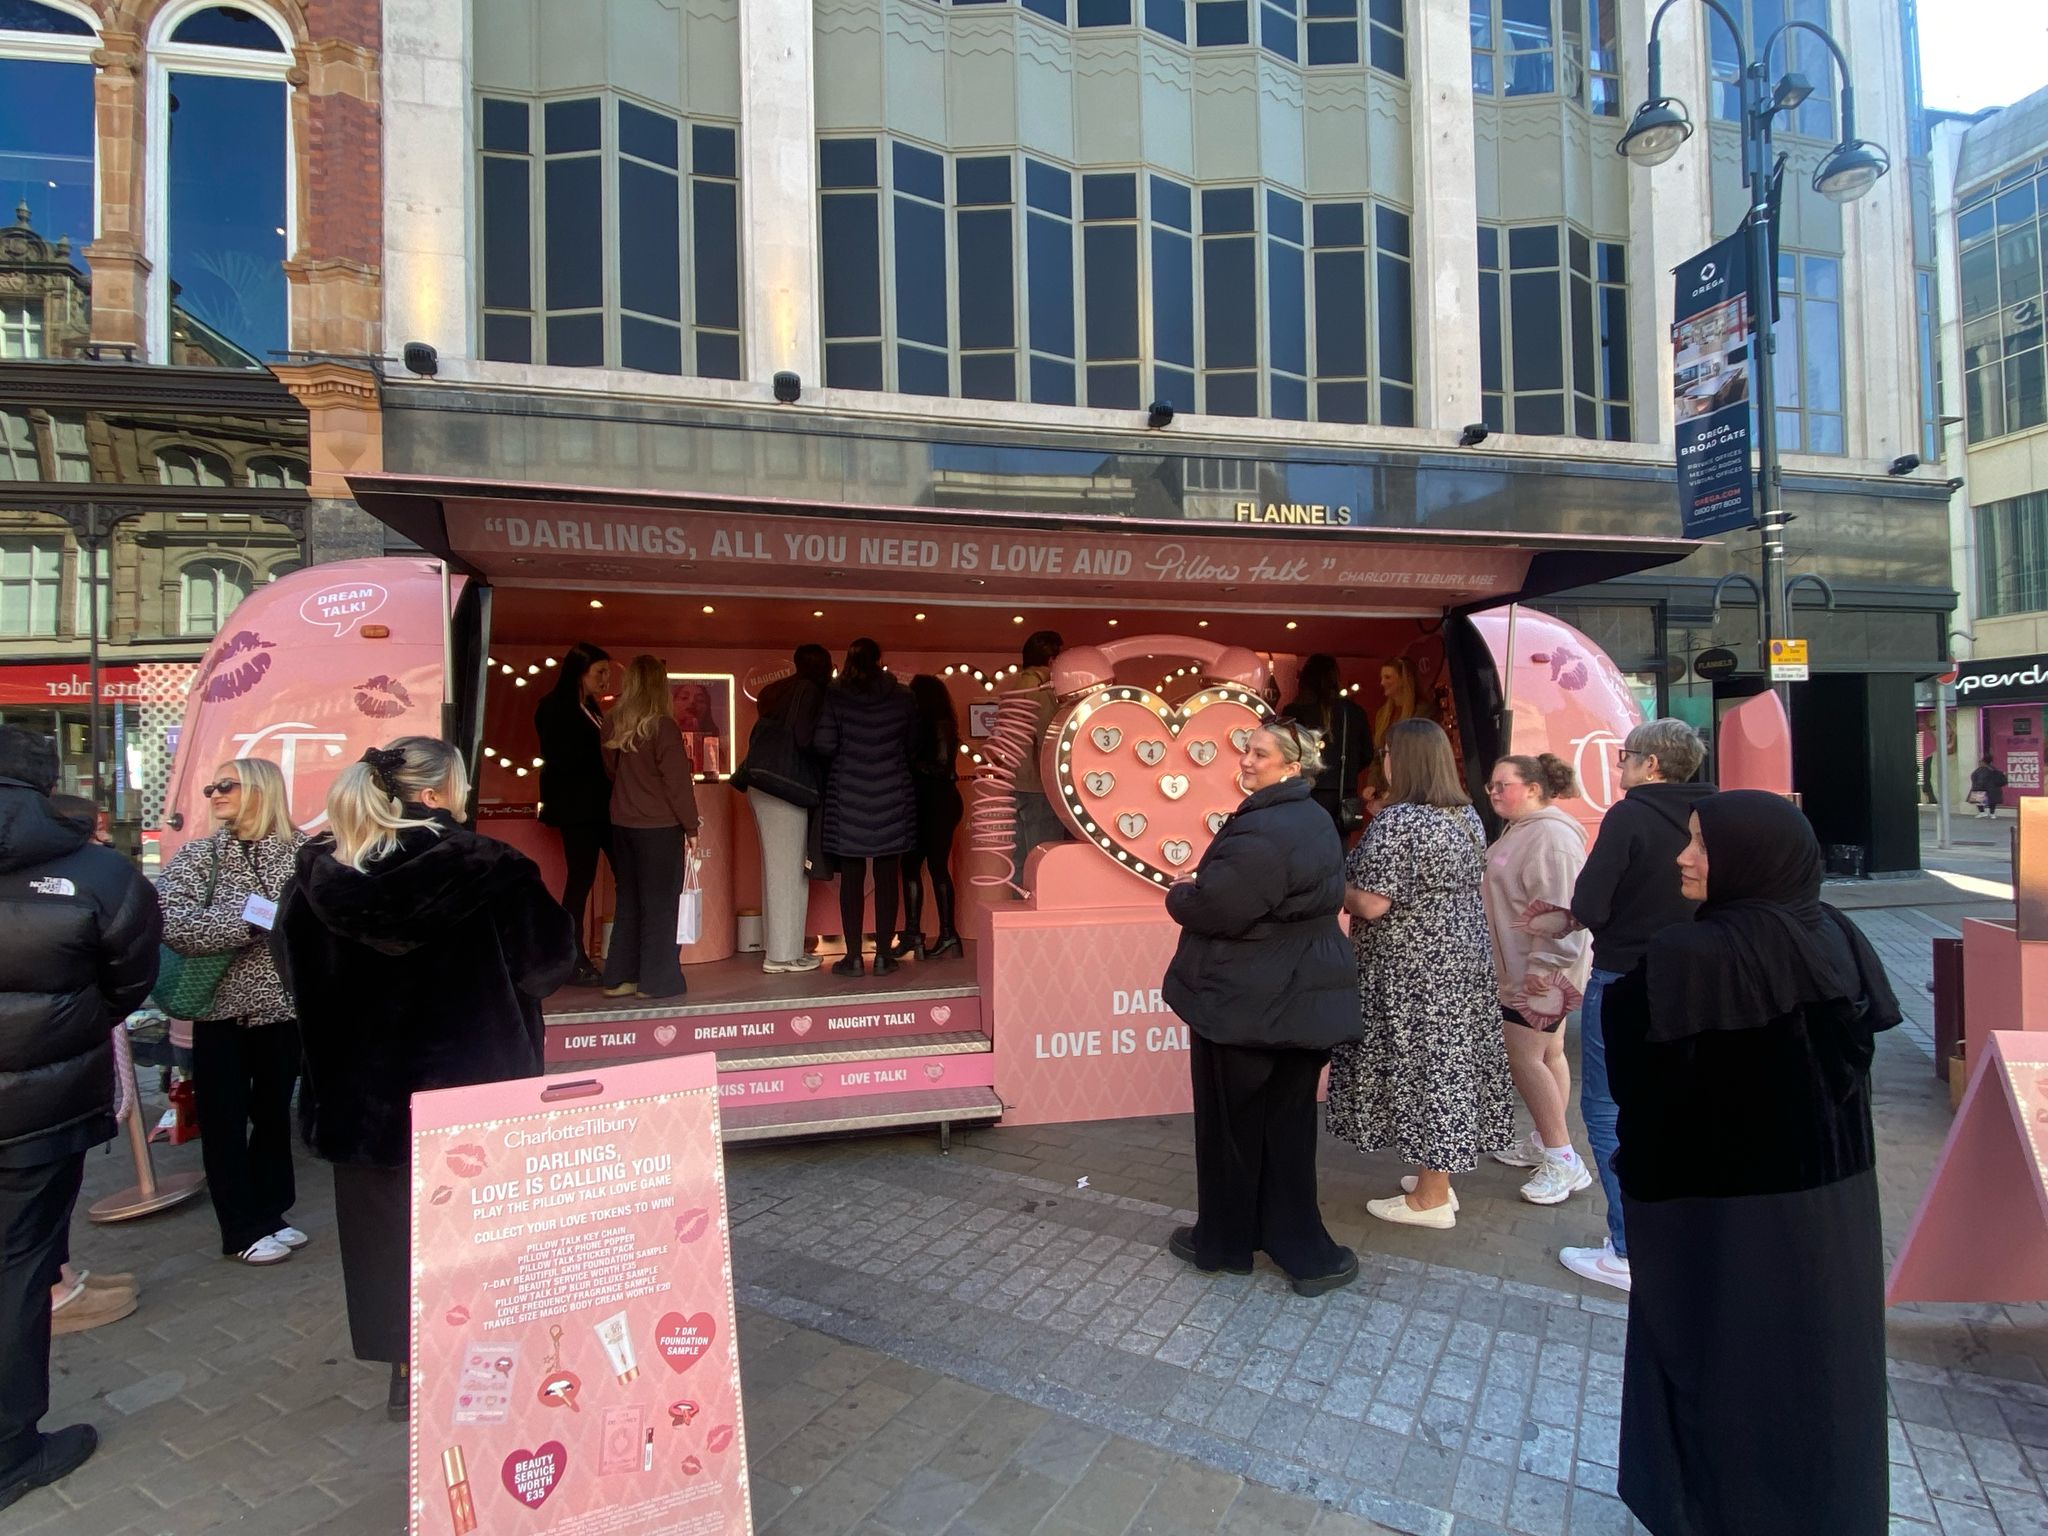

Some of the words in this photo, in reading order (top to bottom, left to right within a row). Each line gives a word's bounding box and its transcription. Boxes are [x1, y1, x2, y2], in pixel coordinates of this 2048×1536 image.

[1692, 276, 1725, 297] OREGA
[1681, 440, 1717, 456] BROAD
[1719, 428, 1746, 444] GATE
[1697, 424, 1731, 441] OREGA
[1714, 448, 1743, 462] OFFICES
[1718, 457, 1742, 469] ROOMS
[1715, 465, 1743, 479] OFFICES
[1235, 502, 1352, 526] FLANNELS
[710, 529, 772, 560] ALL
[783, 533, 848, 564] YOU
[860, 537, 939, 568] NEED
[951, 542, 980, 569] IS
[990, 544, 1063, 574] LOVE
[1072, 549, 1133, 577] AND
[1145, 544, 1239, 583] Pillow
[1338, 570, 1411, 585] CHARLOTTE
[1469, 574, 1498, 586] MBE
[317, 587, 373, 606] DREAM
[322, 601, 367, 618] TALK!
[751, 668, 791, 687] NAUGHTY
[1954, 664, 2048, 695] perd
[1103, 734, 1111, 747] 3
[1147, 748, 1154, 760] 4
[2007, 764, 2039, 774] LASH
[2007, 773, 2040, 783] NAILS
[1095, 779, 1103, 791] 2
[1170, 782, 1178, 794] 5
[1113, 988, 1173, 1016] DAR
[828, 1014, 881, 1031] NAUGHTY
[883, 1012, 915, 1028] TALK!
[565, 1034, 599, 1049] LOVE
[601, 1031, 636, 1047] TALK!
[694, 1025, 738, 1041] DREAM
[740, 1022, 775, 1038] TALK!
[1035, 1030, 1101, 1059] LOVE
[1112, 1029, 1136, 1054] IS
[1146, 1025, 1190, 1052] CAL
[749, 1080, 784, 1095] TALK!
[840, 1072, 873, 1087] LOVE
[874, 1069, 907, 1085] TALK!
[525, 1144, 622, 1174] DARLINGS,
[471, 1181, 520, 1204] LOVE
[525, 1177, 544, 1195] IS
[550, 1163, 626, 1191] CALLING
[631, 1154, 671, 1175] YOU!
[473, 1204, 503, 1220] PLAY
[507, 1201, 530, 1214] THE
[532, 1191, 576, 1210] PILLOW
[578, 1186, 606, 1200] TALK
[609, 1181, 637, 1195] LOVE
[640, 1174, 672, 1190] GAME
[474, 1225, 525, 1244] COLLECT
[528, 1218, 557, 1234] YOUR
[560, 1213, 587, 1228] LOVE
[590, 1206, 632, 1224] TOKENS
[634, 1201, 648, 1213] TO
[651, 1196, 675, 1210] WIN!
[518, 1251, 550, 1264] PILLOW
[551, 1246, 573, 1257] TALK
[575, 1239, 602, 1253] PHONE
[604, 1233, 635, 1247] POPPER
[527, 1240, 558, 1253] PILLOW
[560, 1234, 583, 1246] TALK
[584, 1231, 599, 1242] KEY
[601, 1227, 626, 1238] CHAIN
[513, 1268, 560, 1285] BEAUTIFUL
[561, 1264, 581, 1275] SKIN
[583, 1253, 635, 1270] FOUNDATION
[636, 1245, 668, 1259] SAMPLE
[520, 1260, 551, 1274] PILLOW
[553, 1255, 574, 1266] TALK
[576, 1248, 611, 1262] STICKER
[612, 1243, 634, 1255] PACK
[495, 1294, 528, 1308] PILLOW
[530, 1288, 552, 1300] TALK
[553, 1285, 568, 1296] LIP
[569, 1280, 591, 1292] BLUR
[593, 1273, 625, 1287] DELUXE
[626, 1265, 658, 1280] SAMPLE
[518, 1280, 552, 1294] BEAUTY
[553, 1271, 589, 1286] SERVICE
[590, 1264, 620, 1278] WORTH
[621, 1261, 637, 1272] £35
[497, 1305, 521, 1318] LOVE
[522, 1294, 572, 1312] FREQUENCY
[573, 1283, 622, 1302] FRAGRANCE
[624, 1275, 657, 1290] SAMPLE
[483, 1315, 517, 1330] TRAVEL
[518, 1311, 539, 1323] SIZE
[540, 1304, 568, 1318] MAGIC
[570, 1299, 593, 1311] BODY
[595, 1292, 624, 1306] CREAM
[625, 1286, 654, 1299] WORTH
[660, 1336, 708, 1346] FOUNDATION
[674, 1327, 681, 1336] 7
[682, 1327, 698, 1336] DAY
[666, 1346, 699, 1356] SAMPLE
[514, 1463, 556, 1484] SERVICE
[515, 1454, 554, 1474] BEAUTY
[517, 1476, 553, 1495] WORTH
[526, 1488, 545, 1502] £35
